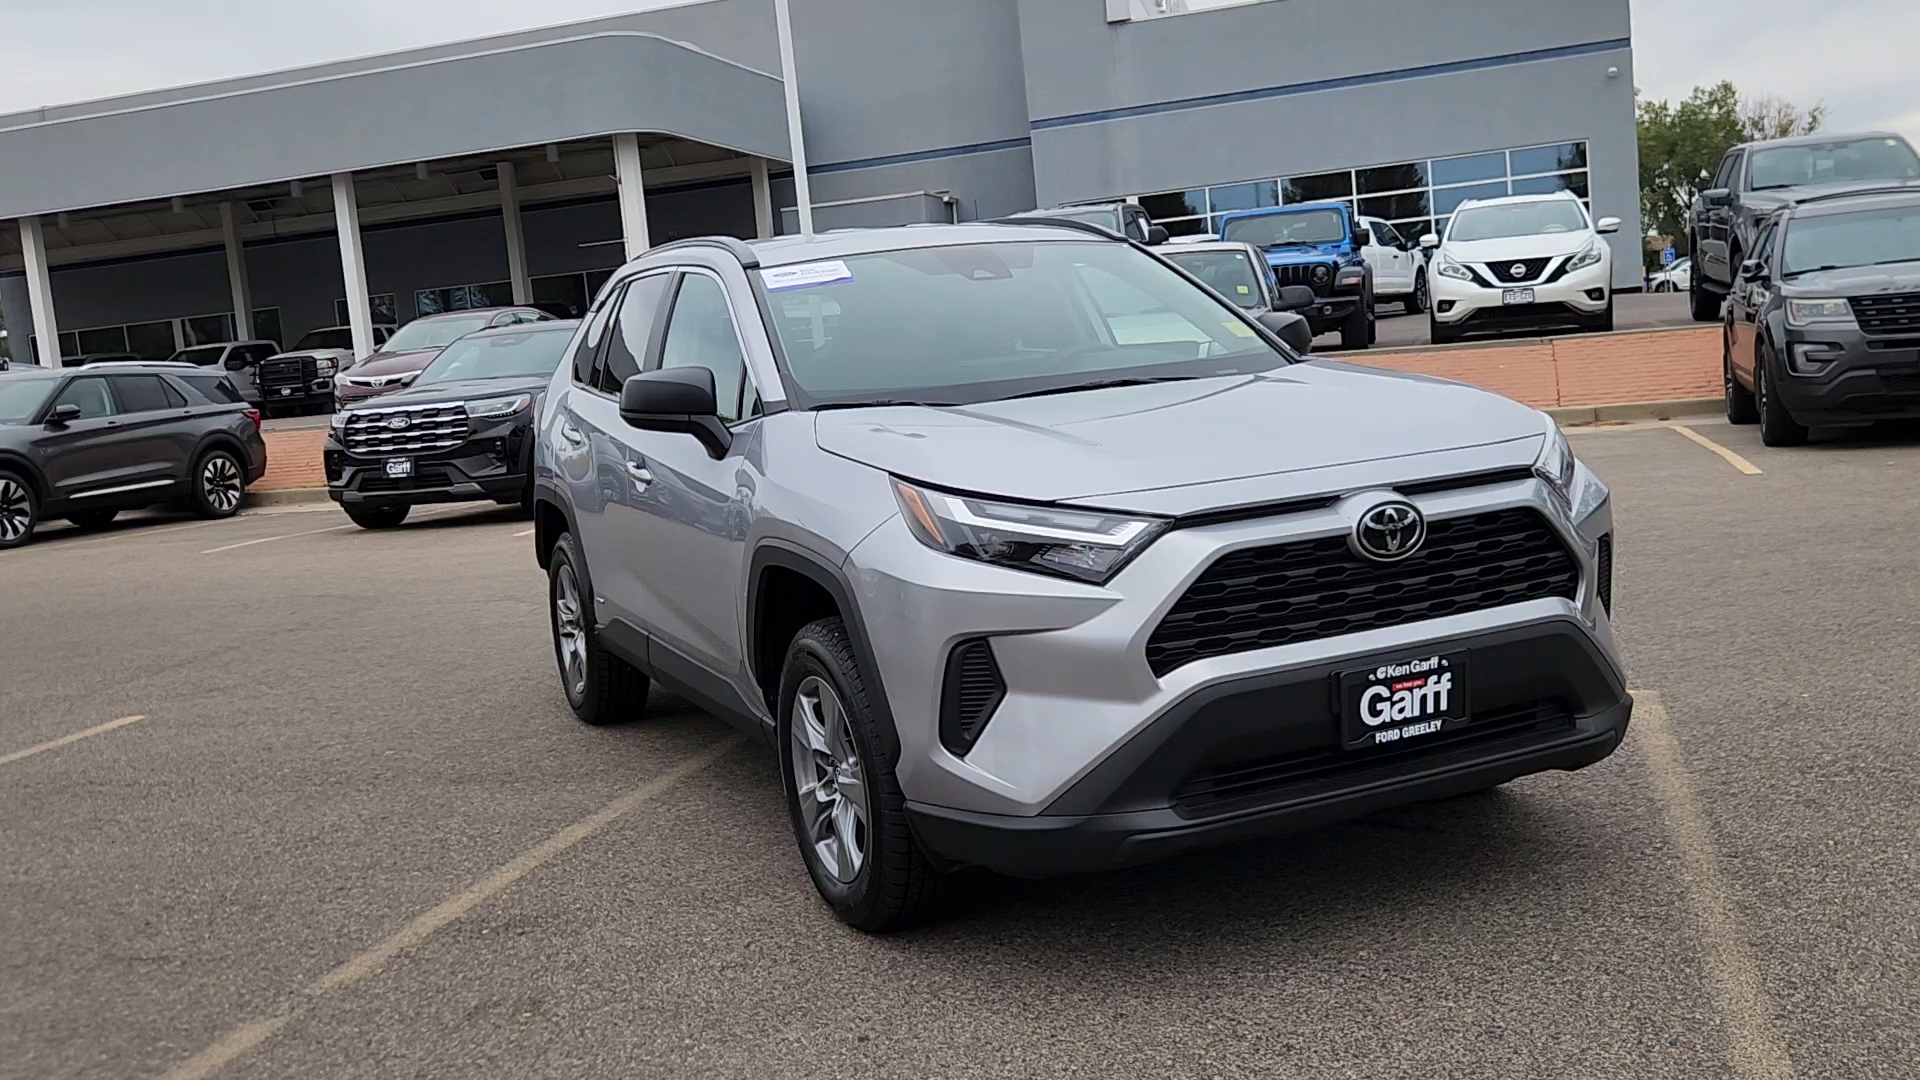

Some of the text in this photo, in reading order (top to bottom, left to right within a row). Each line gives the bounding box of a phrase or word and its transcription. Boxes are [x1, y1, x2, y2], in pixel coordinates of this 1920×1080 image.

[386, 461, 411, 474] Garff
[1387, 656, 1439, 678] Ken Garff
[1360, 672, 1451, 726] Garff
[1375, 720, 1442, 744] FORD GREELEY
